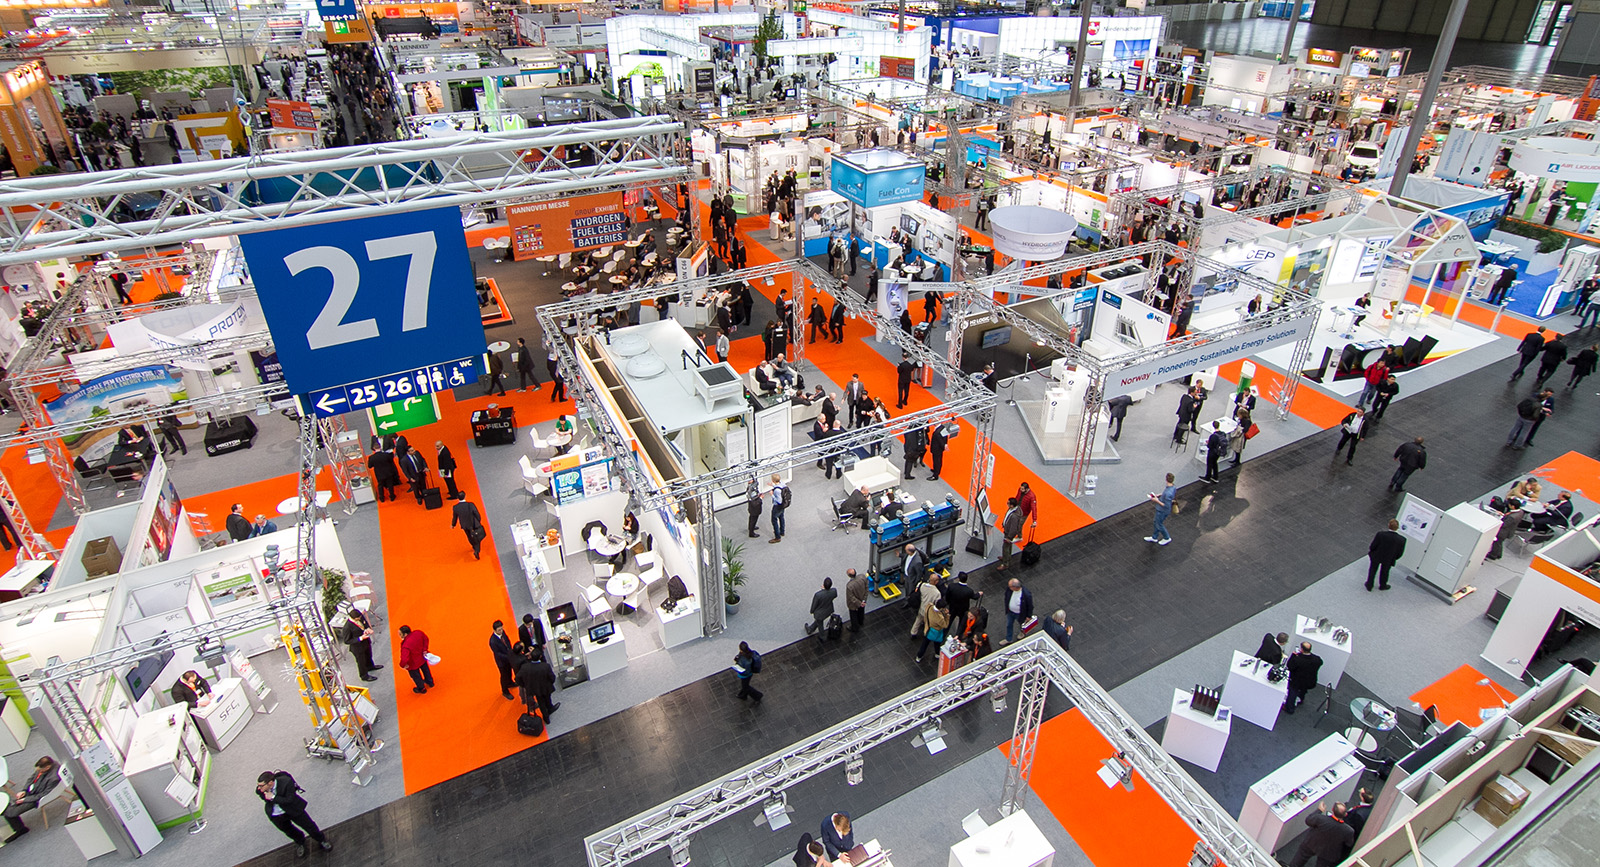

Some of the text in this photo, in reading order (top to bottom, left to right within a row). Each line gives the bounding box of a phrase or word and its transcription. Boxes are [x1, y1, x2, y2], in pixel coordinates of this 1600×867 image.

[1312, 54, 1334, 63] KOREA
[1354, 54, 1380, 63] CHINA
[838, 180, 857, 195] FuelCon
[878, 188, 910, 197] FuelCon
[511, 201, 570, 214] HANNOVER MESSE
[576, 214, 620, 227] HYDROGEN
[577, 223, 622, 237] FUEL CELLS
[578, 233, 623, 247] BATTERIES
[1246, 249, 1276, 260] CEP
[283, 230, 438, 350] 27
[1009, 285, 1049, 294] HYDROGENICS
[209, 303, 246, 338] PROTON
[1120, 372, 1151, 387] Norway
[1157, 358, 1198, 375] Pioneering
[1199, 345, 1240, 363] Sustainable
[1240, 339, 1265, 351] Energy
[1266, 328, 1297, 342] Solutions
[86, 382, 103, 394] SCALE
[103, 378, 115, 387] PEM
[118, 378, 142, 388] ENERGY
[350, 359, 473, 405] 25 26 WC
[216, 439, 241, 449] PROTON
[219, 699, 239, 722] SFC
